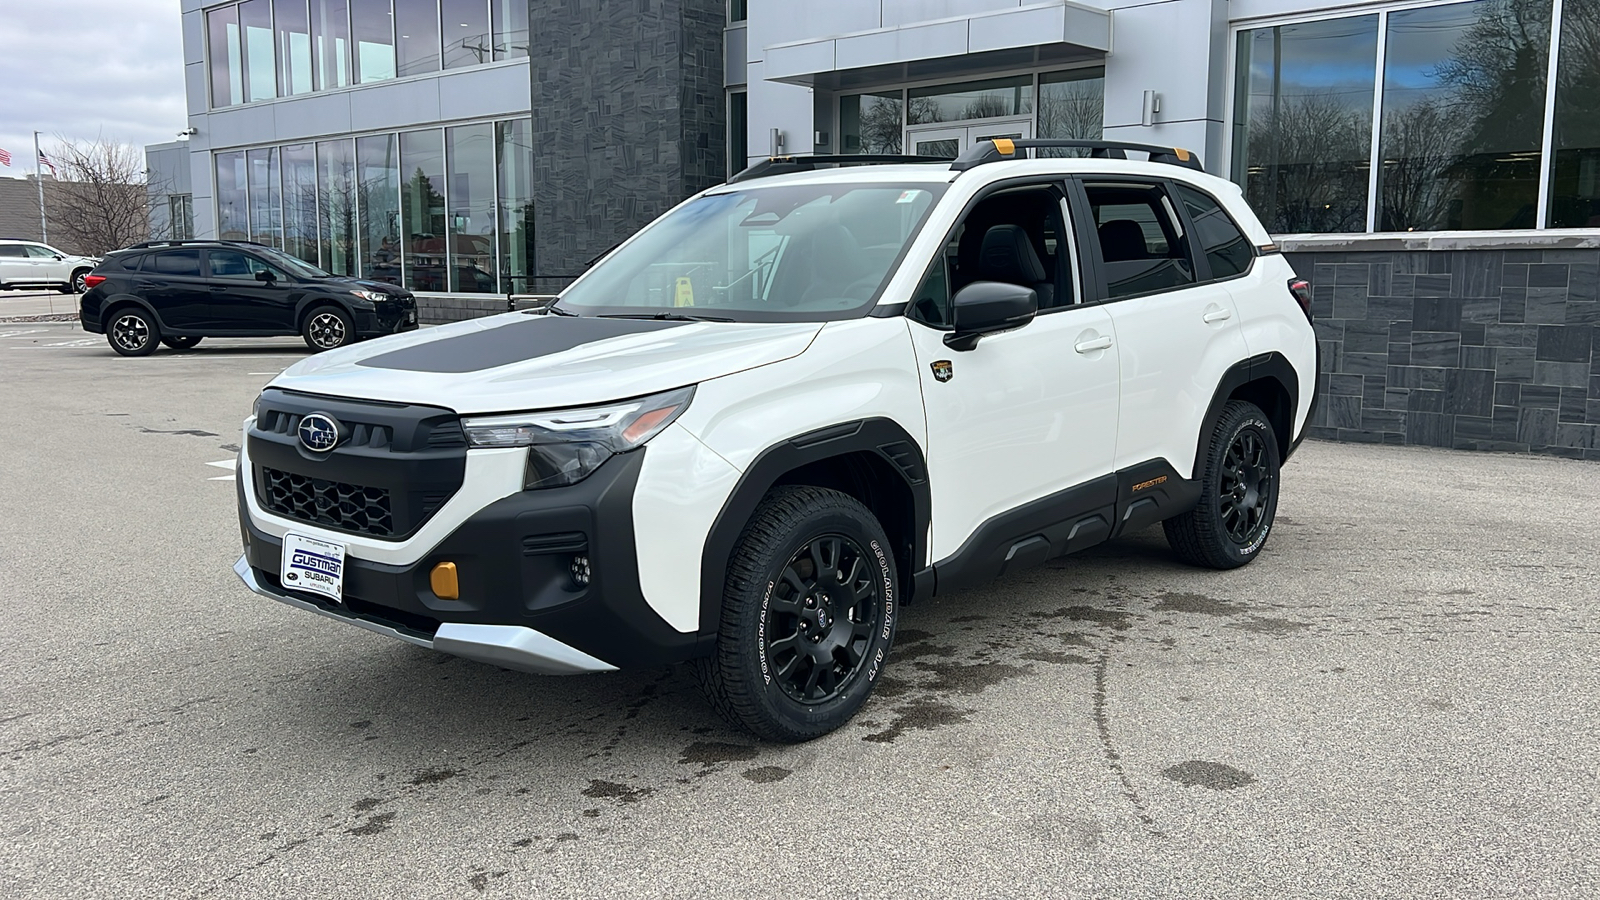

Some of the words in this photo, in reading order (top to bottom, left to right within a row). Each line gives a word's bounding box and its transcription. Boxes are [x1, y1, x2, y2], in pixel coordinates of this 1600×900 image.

[1132, 475, 1168, 492] FORESTER
[304, 571, 334, 585] SUBARU
[870, 539, 893, 640] GEOLANDAR
[758, 580, 775, 686] YOKOHAMA
[868, 647, 884, 682] A/T
